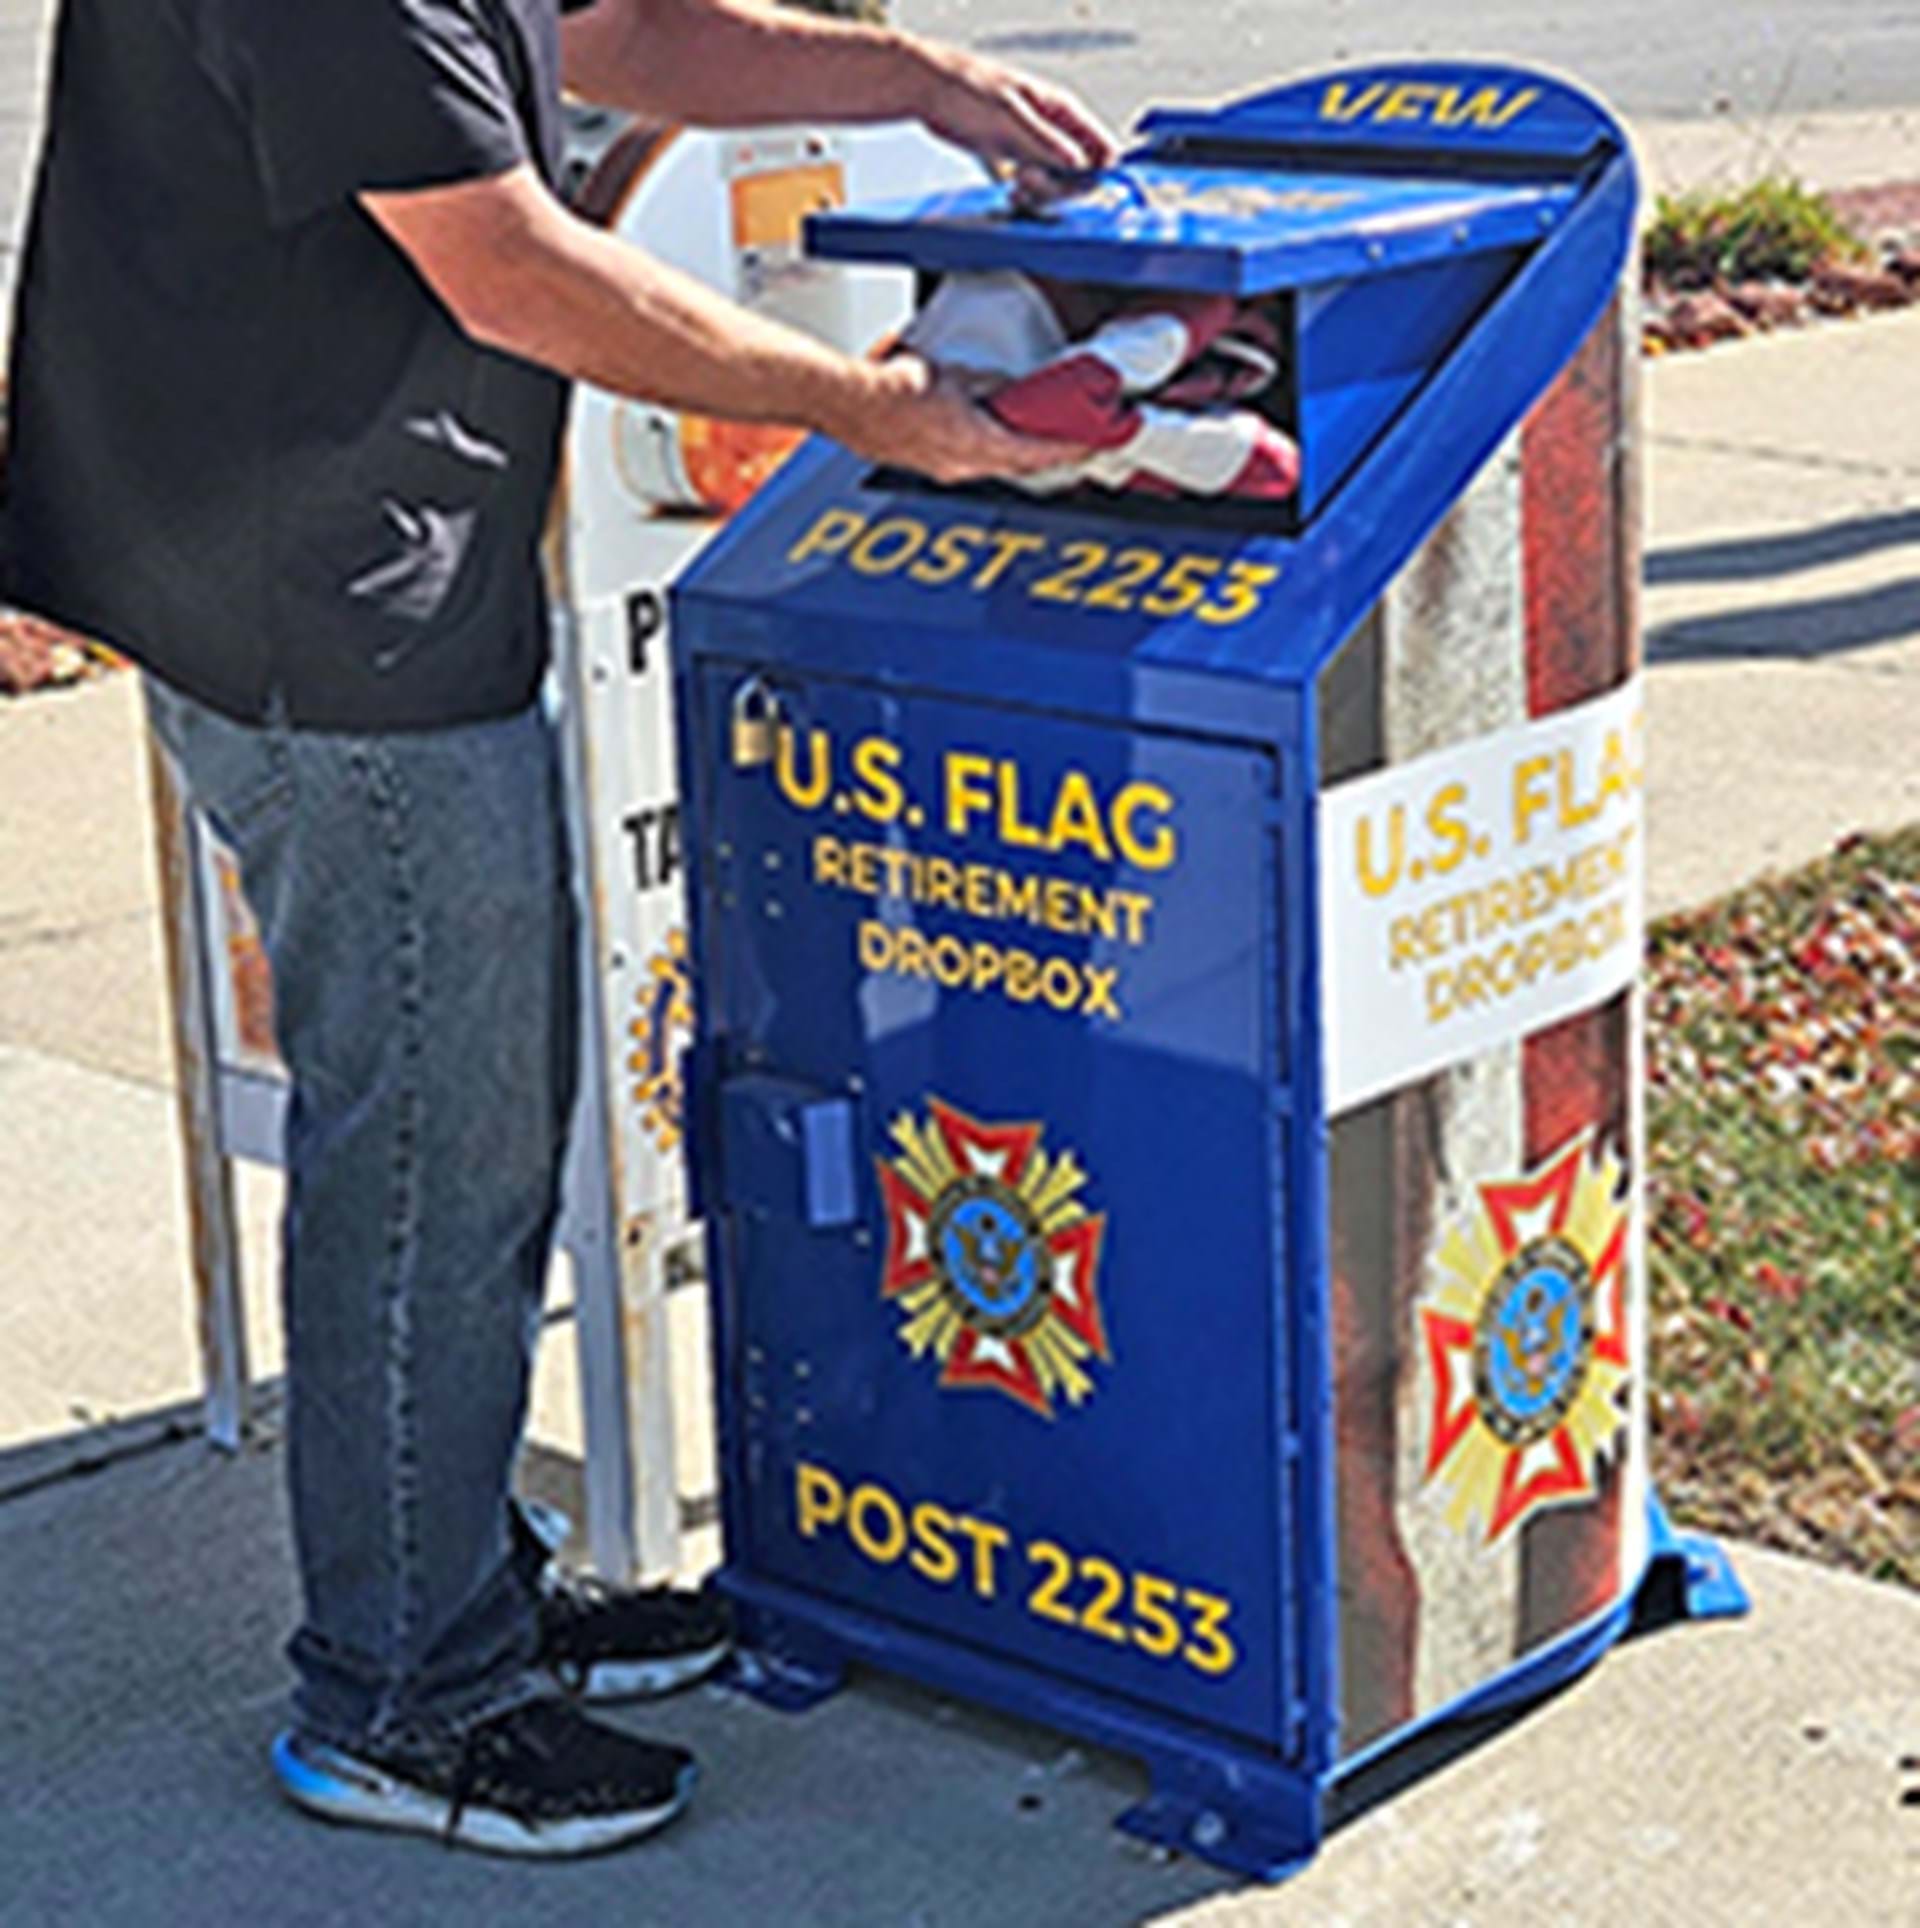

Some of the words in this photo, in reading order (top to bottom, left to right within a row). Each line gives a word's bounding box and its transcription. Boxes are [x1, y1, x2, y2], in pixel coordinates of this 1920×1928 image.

[1319, 82, 1541, 128] VFW
[787, 508, 1045, 589] POST
[1029, 542, 1279, 624] 2253
[775, 724, 925, 828] U.S.
[945, 751, 1178, 870] FLAG
[1355, 782, 1491, 899] U.S.
[813, 835, 1154, 944] RETIREMENT
[857, 919, 1122, 1020] DROPBOX
[795, 1460, 1009, 1597] POST
[1026, 1539, 1236, 1676] 2253
